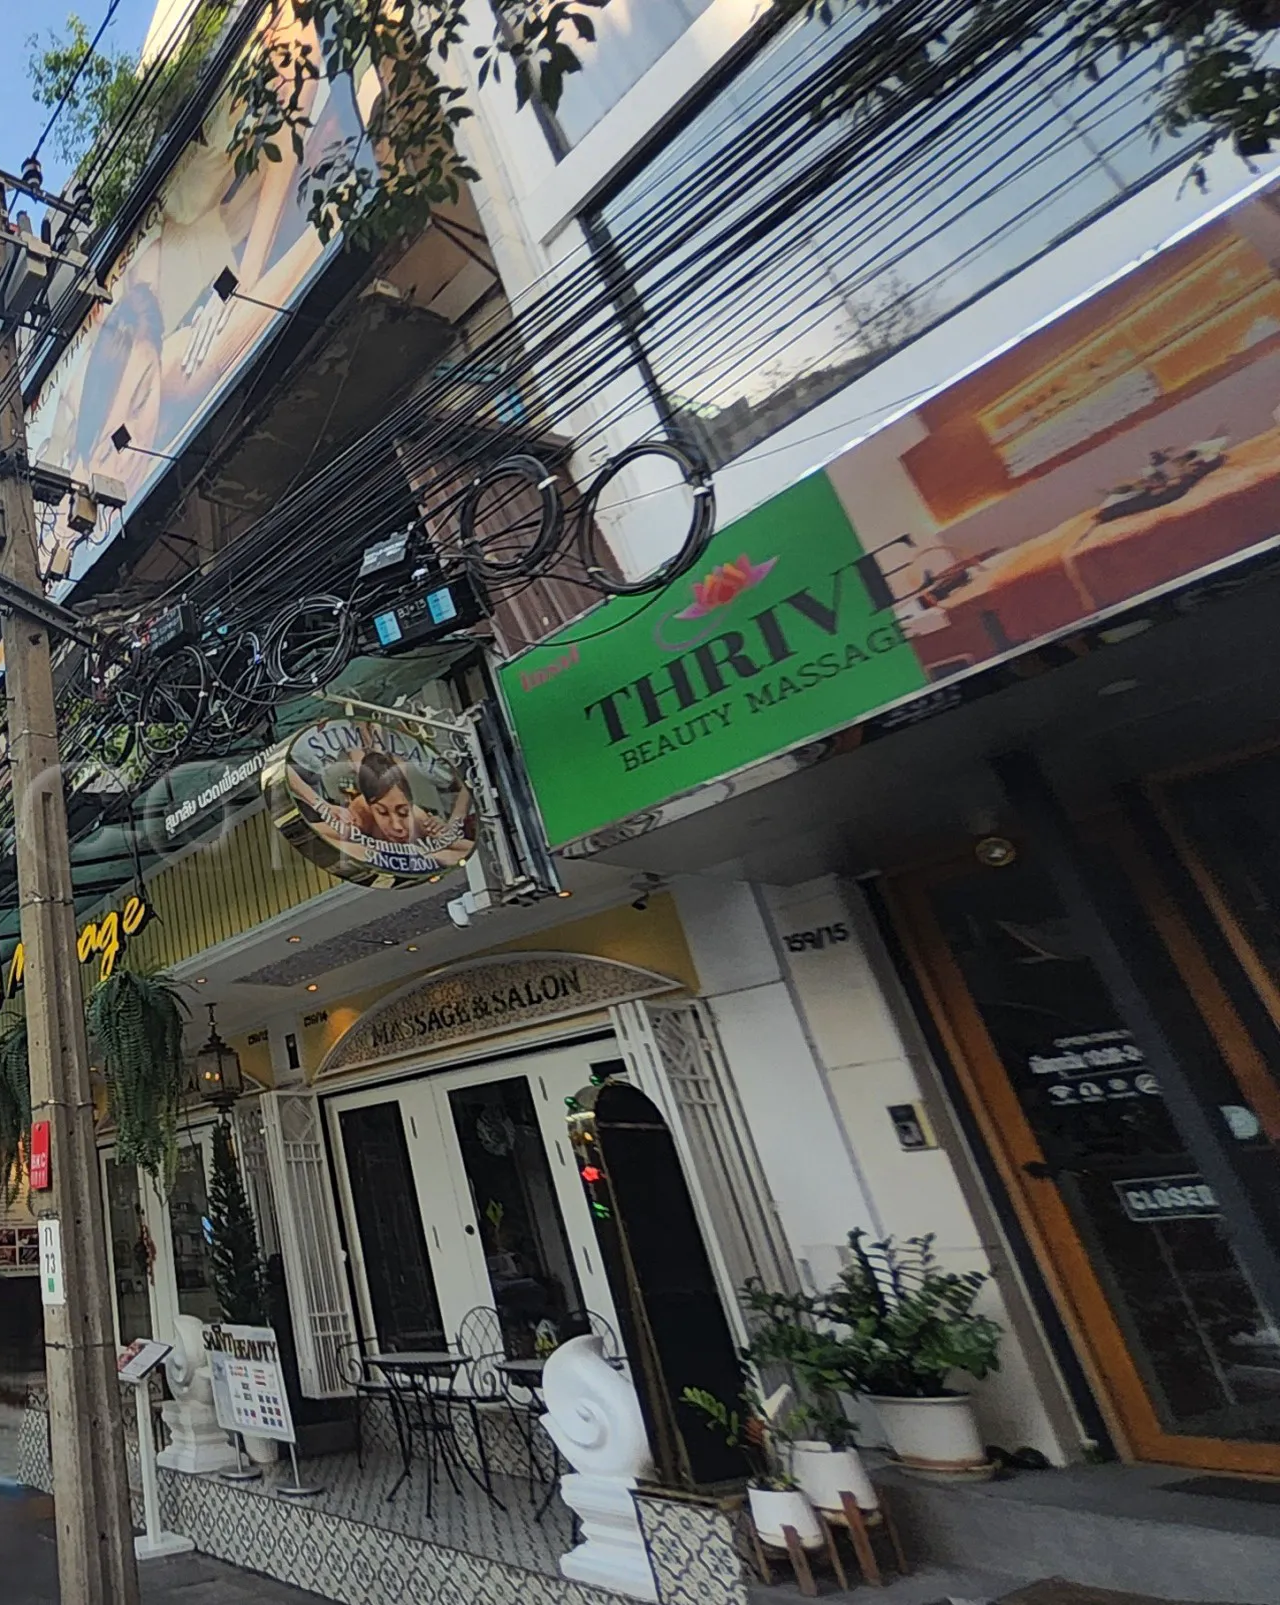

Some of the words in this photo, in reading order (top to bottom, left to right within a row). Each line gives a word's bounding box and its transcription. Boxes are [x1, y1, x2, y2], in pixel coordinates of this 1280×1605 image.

[583, 532, 917, 747] THRIVE
[620, 702, 733, 773] BEAUTY
[742, 612, 914, 714] MASSAGE
[307, 725, 438, 775] SUMALAI
[350, 824, 419, 857] Premium
[364, 848, 408, 872] SINCE
[408, 855, 440, 872] 2001
[370, 997, 471, 1048] MASSAGE
[491, 968, 582, 1012] SALON
